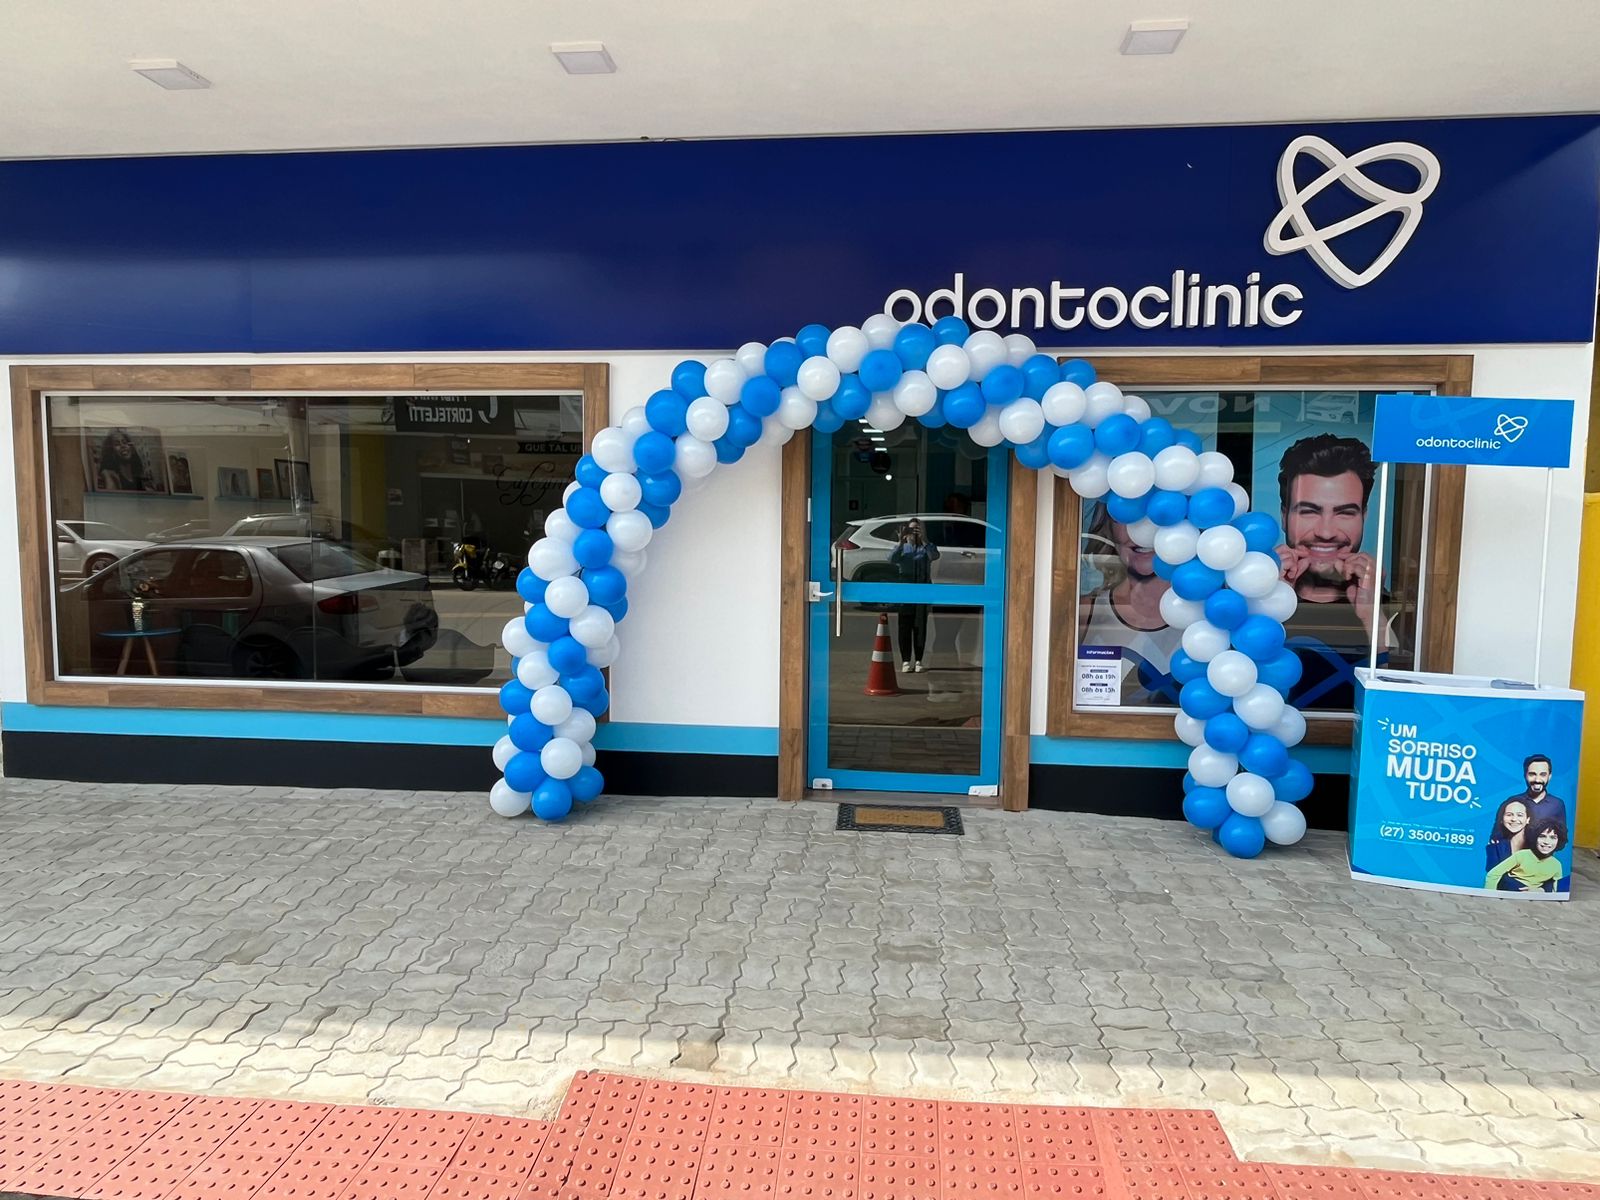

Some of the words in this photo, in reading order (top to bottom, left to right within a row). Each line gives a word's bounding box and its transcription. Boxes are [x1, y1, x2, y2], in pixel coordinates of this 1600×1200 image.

[883, 269, 1303, 330] odontoclinic
[525, 443, 546, 452] QUE
[549, 443, 568, 453] TAL
[1416, 436, 1501, 449] odontoclinic
[1390, 723, 1417, 738] UM
[1388, 738, 1477, 760] SORRISO
[1386, 754, 1477, 785] MUDA
[1405, 781, 1472, 804] TUDO
[1380, 824, 1404, 839] (27)
[1408, 829, 1474, 845] 3500-1899
